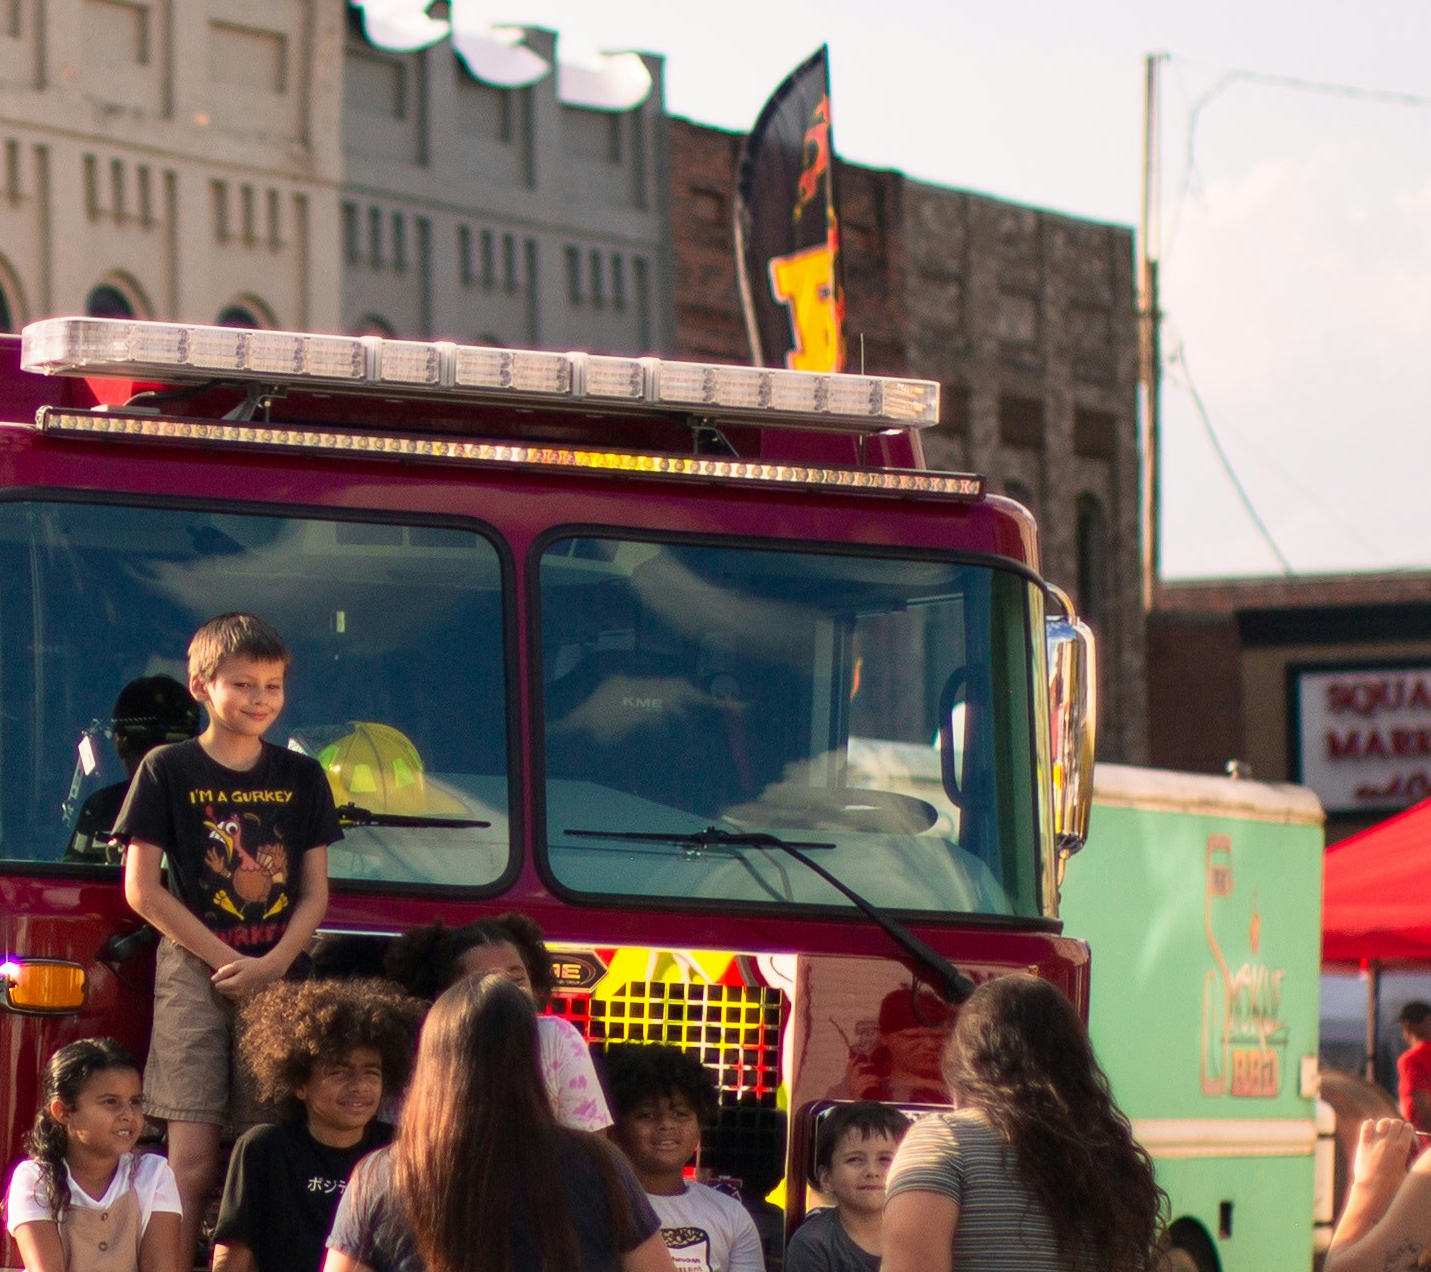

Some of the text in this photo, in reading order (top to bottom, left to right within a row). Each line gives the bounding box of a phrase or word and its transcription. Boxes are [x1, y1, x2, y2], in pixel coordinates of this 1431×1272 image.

[190, 789, 293, 804] I'M A GURKEY
